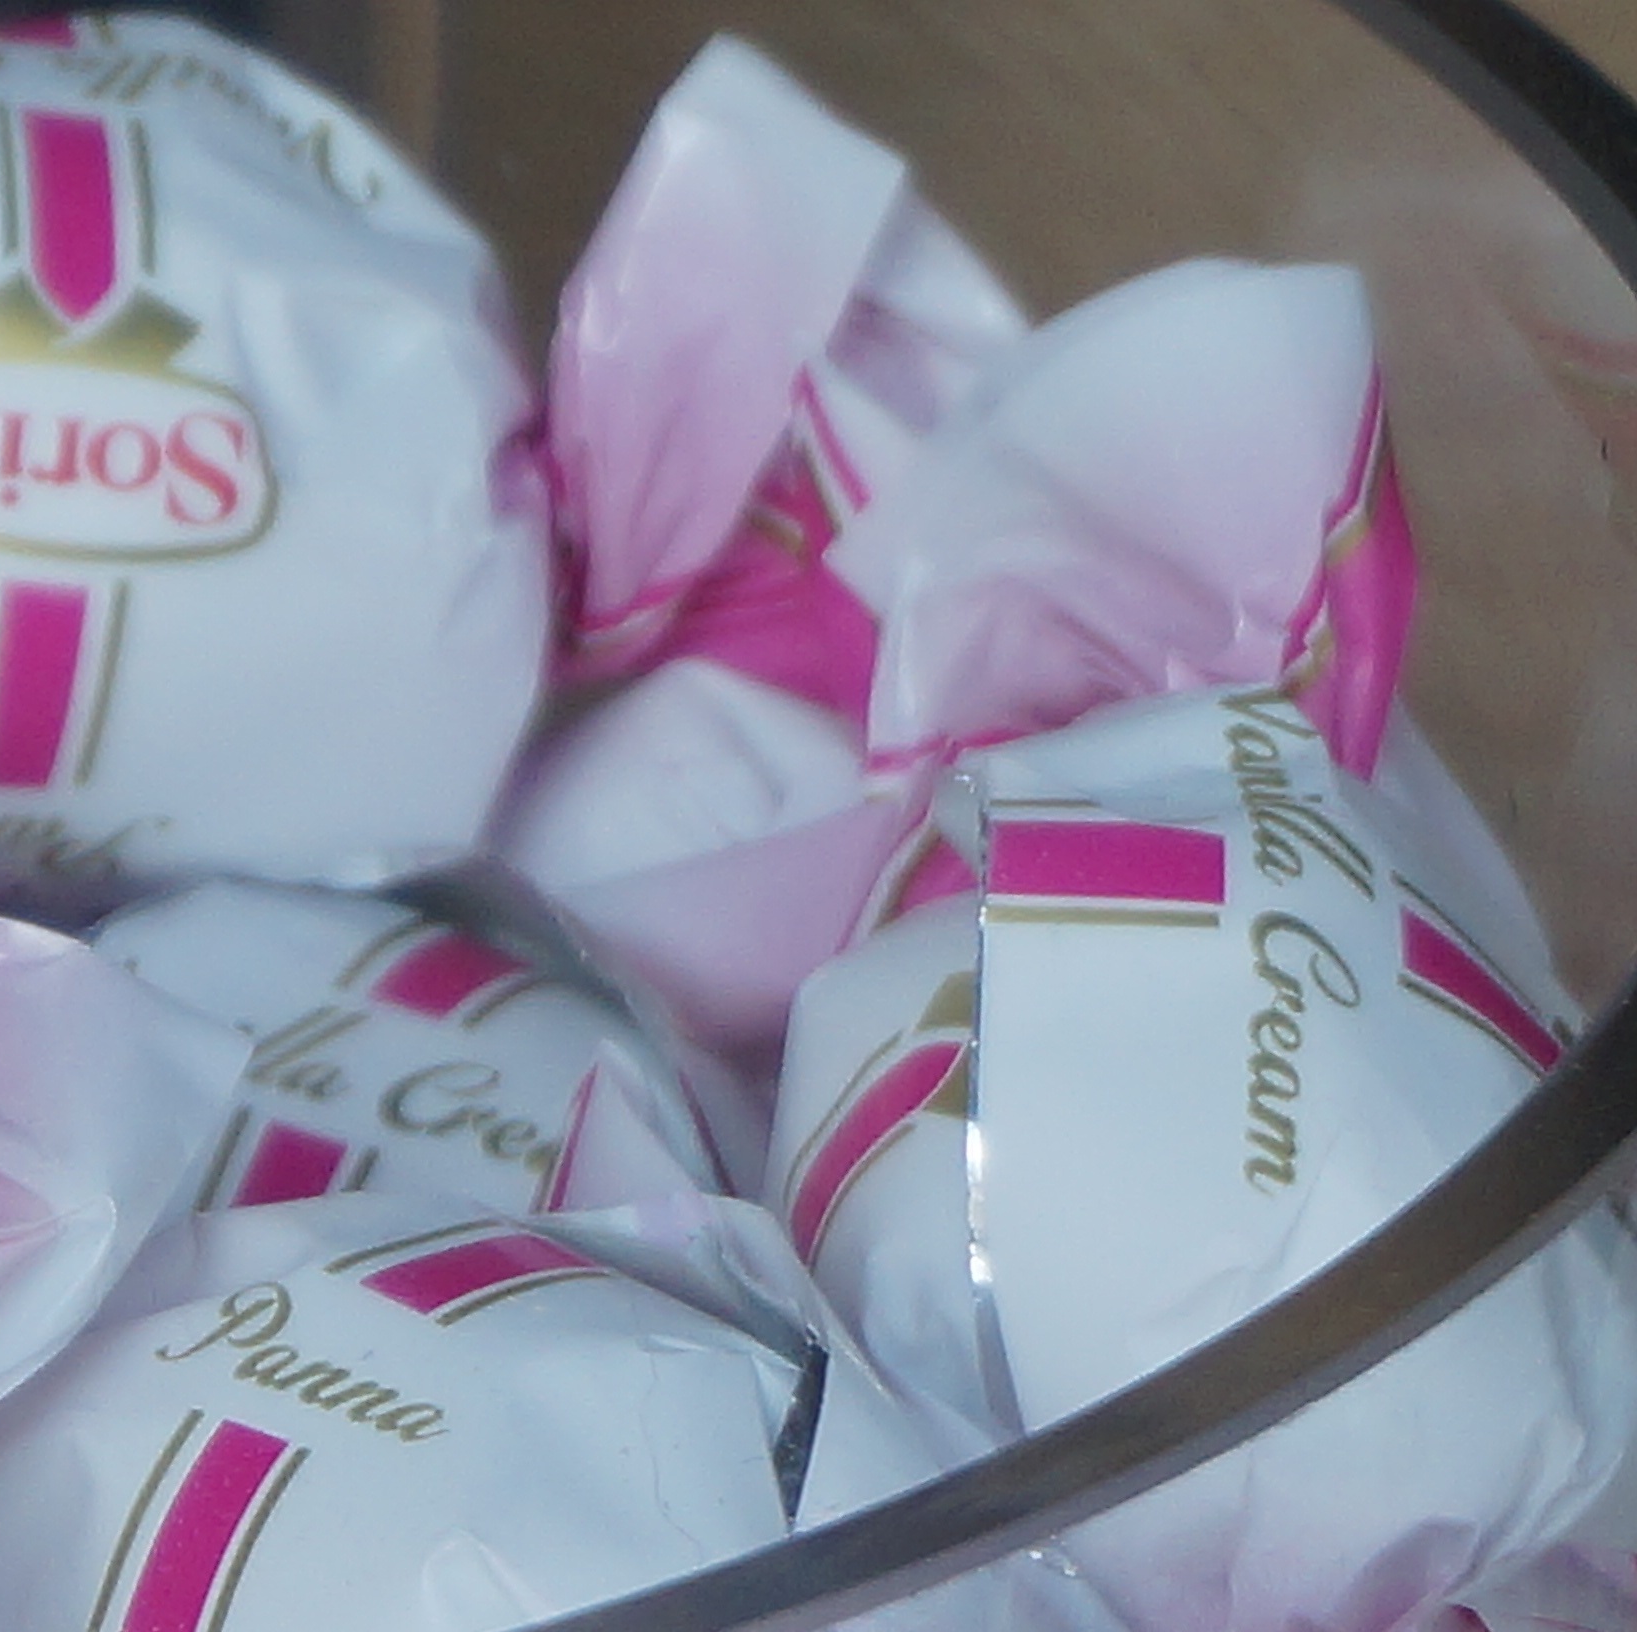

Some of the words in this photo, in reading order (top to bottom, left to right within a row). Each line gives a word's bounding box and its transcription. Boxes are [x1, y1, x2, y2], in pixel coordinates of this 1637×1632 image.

[1217, 688, 1377, 903] Vanilla
[1240, 909, 1362, 1198] Cream
[154, 1281, 453, 1444] Panna
